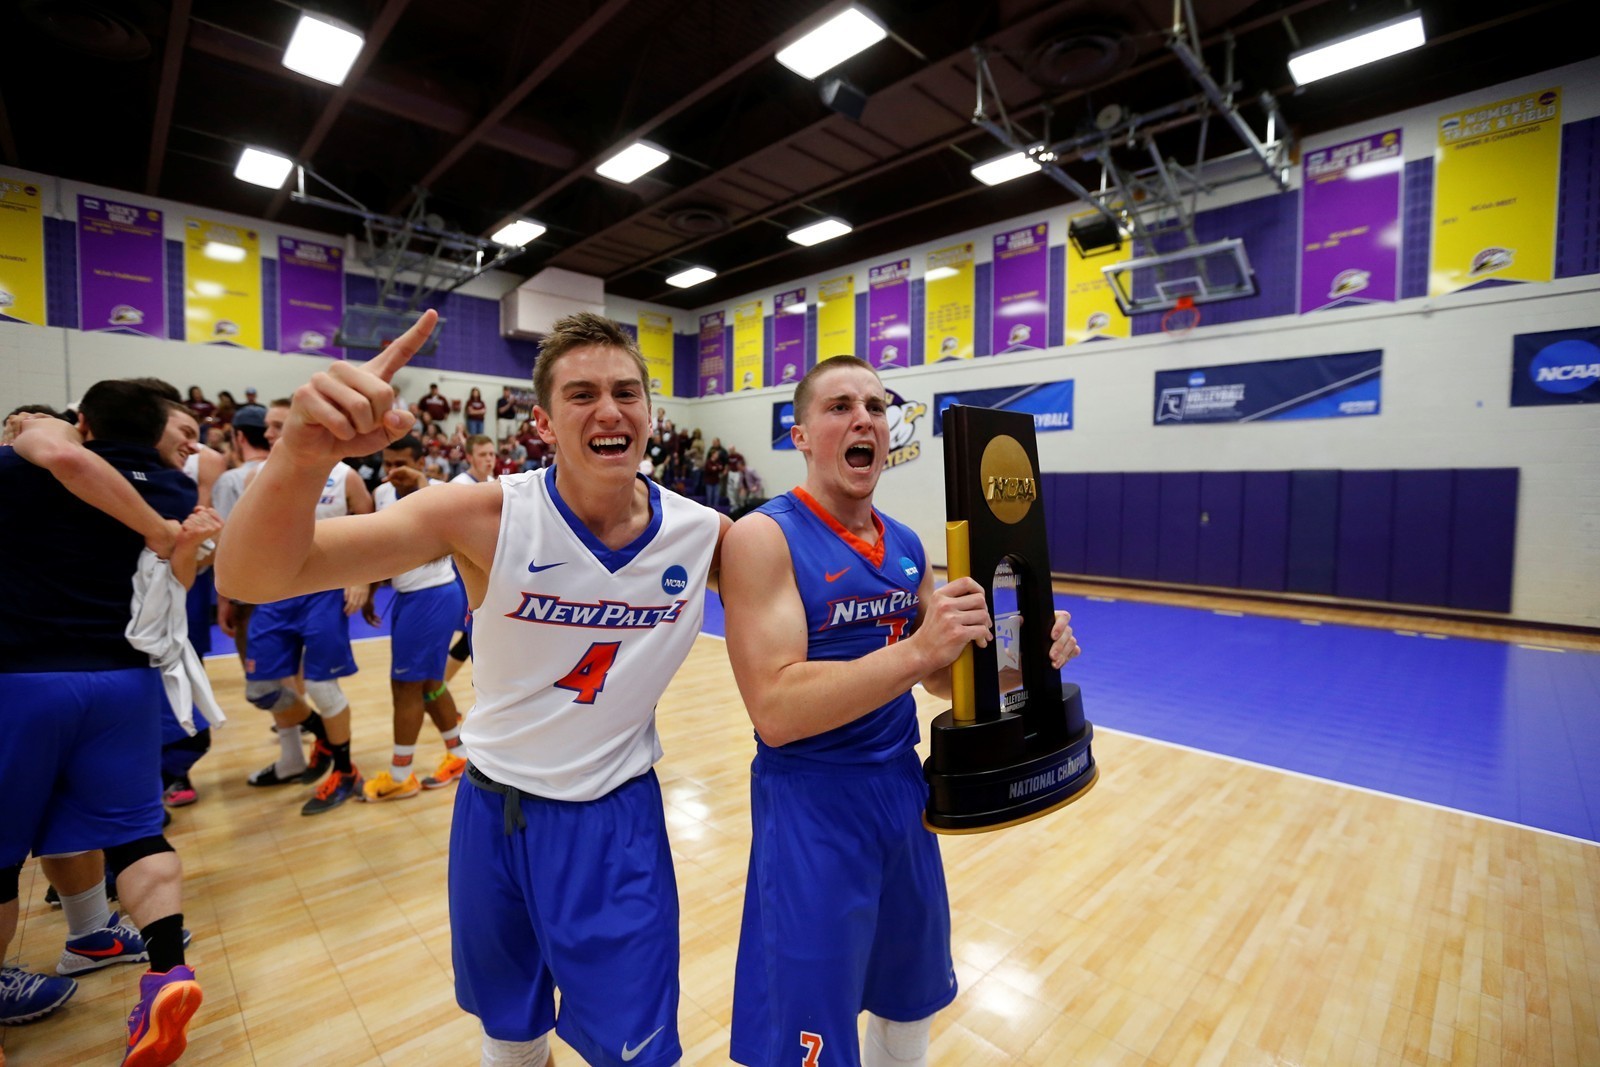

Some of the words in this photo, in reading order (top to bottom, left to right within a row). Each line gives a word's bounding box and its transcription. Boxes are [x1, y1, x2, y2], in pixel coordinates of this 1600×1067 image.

[1444, 121, 1491, 141] TRACK
[1511, 104, 1556, 125] FIELD
[1465, 98, 1534, 124] WOMEN'S
[1536, 363, 1600, 382] NCAA
[1033, 412, 1070, 429] EYBALL
[881, 440, 920, 472] YERS
[986, 475, 1036, 500] NCAA
[664, 578, 686, 589] NCAA
[553, 641, 622, 705] 4
[1004, 690, 1029, 706] OLLEYBALL
[1009, 770, 1056, 799] NATIONAL
[800, 1031, 824, 1067] 7
